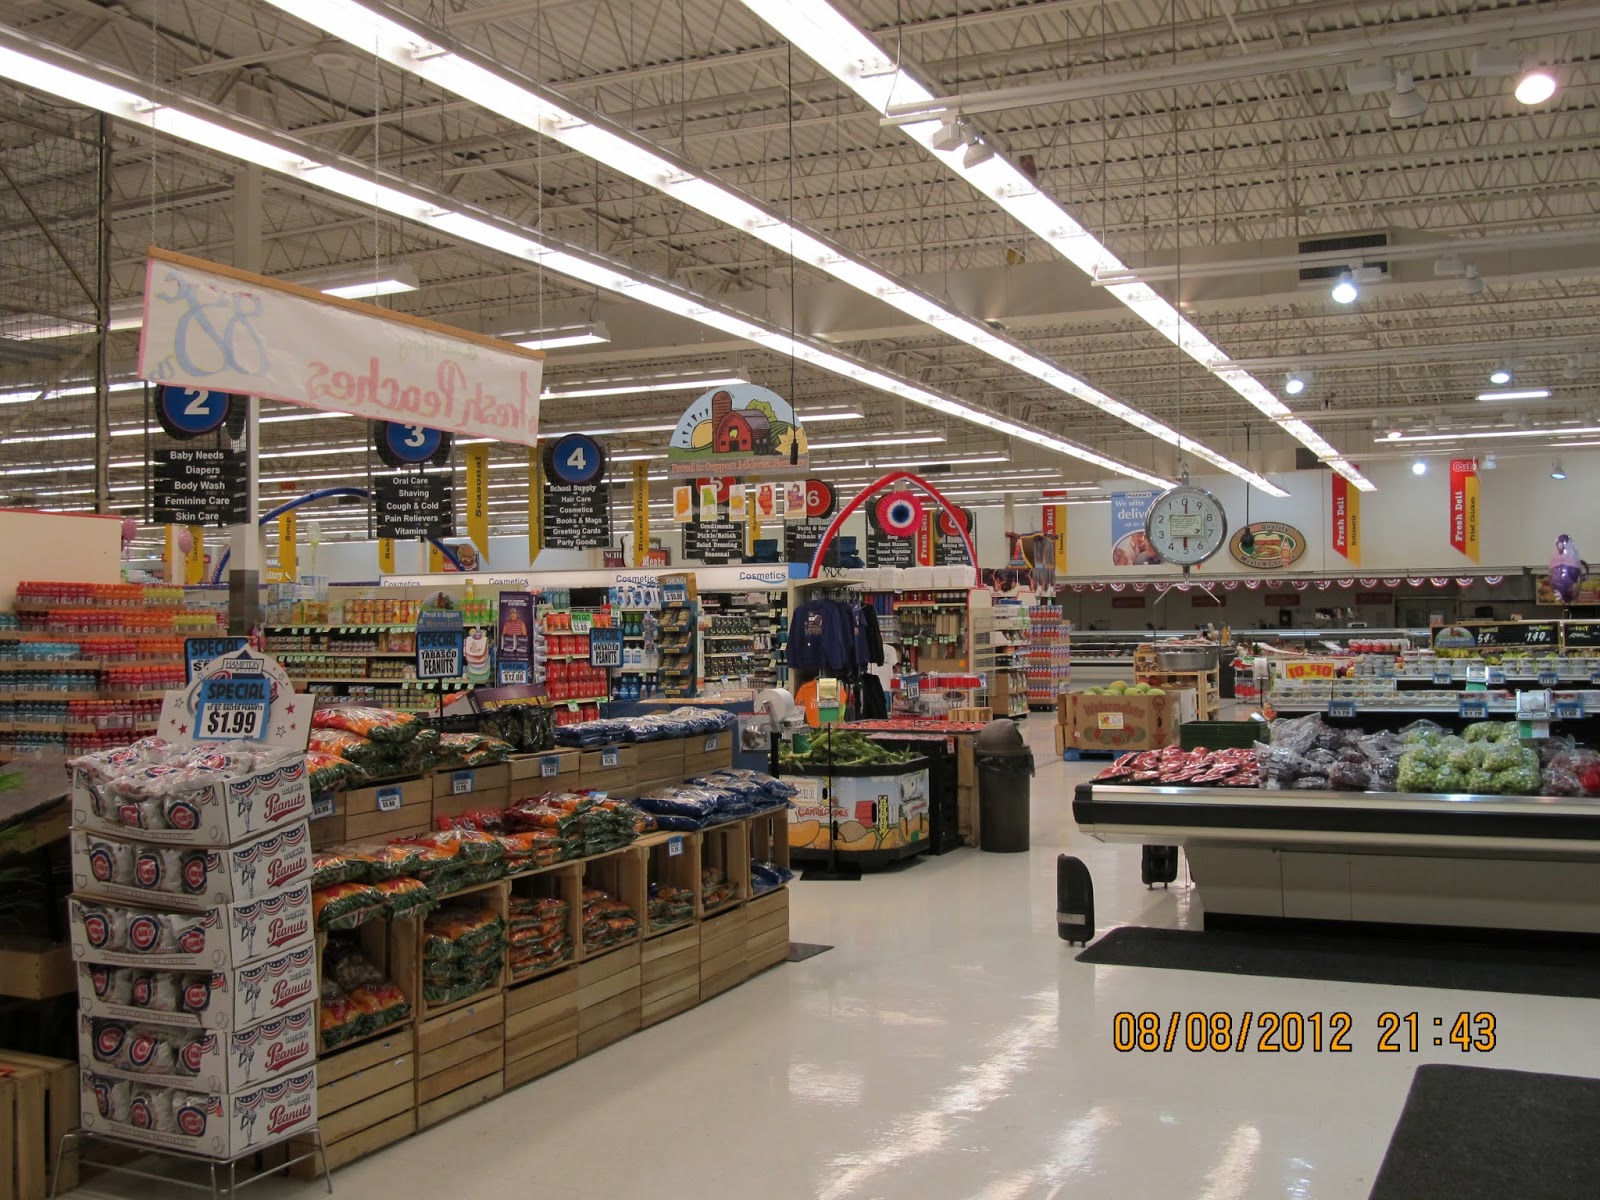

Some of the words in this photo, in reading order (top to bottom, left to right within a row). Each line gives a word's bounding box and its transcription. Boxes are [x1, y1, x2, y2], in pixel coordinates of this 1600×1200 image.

[184, 388, 209, 414] 2
[404, 424, 426, 447] 3
[170, 451, 193, 461] Baby
[196, 451, 224, 460] Needs
[567, 447, 586, 470] 4
[186, 466, 220, 475] Diapers
[174, 481, 198, 491] Body
[200, 481, 225, 490] Wash
[574, 484, 597, 492] Supply
[709, 476, 724, 490] 5
[398, 490, 430, 498] Shaving
[806, 490, 820, 506] 6
[165, 496, 206, 505] Feminine
[208, 496, 230, 505] Care
[1182, 498, 1188, 506] 0
[386, 502, 412, 510] Cough
[1196, 502, 1202, 510] 9
[1336, 496, 1344, 516] Deli
[176, 512, 196, 520] Skin
[198, 512, 219, 520] Care
[1158, 515, 1164, 524] 2
[1206, 514, 1212, 522] 8
[1262, 524, 1290, 532] Quality
[1159, 531, 1164, 539] 3
[1208, 529, 1214, 538] 7
[1168, 542, 1174, 550] 4
[1198, 542, 1204, 550] 6
[642, 555, 666, 566] Meats
[616, 575, 659, 583] Cosmetics
[740, 572, 786, 580] Cosmetics
[420, 635, 458, 647] SPECIAL
[421, 650, 456, 660] TABASCO
[596, 651, 617, 664] PEANUTS
[226, 660, 260, 668] HAMPTON
[424, 659, 454, 674] PEANUTS
[207, 682, 266, 700] SPECIAL
[1083, 702, 1145, 718] Watermelons
[207, 711, 257, 735] $1.99
[264, 793, 306, 820] Peanuts
[267, 858, 308, 884] Peanuts
[267, 918, 308, 944] Peanuts
[270, 979, 312, 1006] Peanuts
[265, 1042, 310, 1068] Peanuts
[267, 1104, 312, 1132] Peanuts
